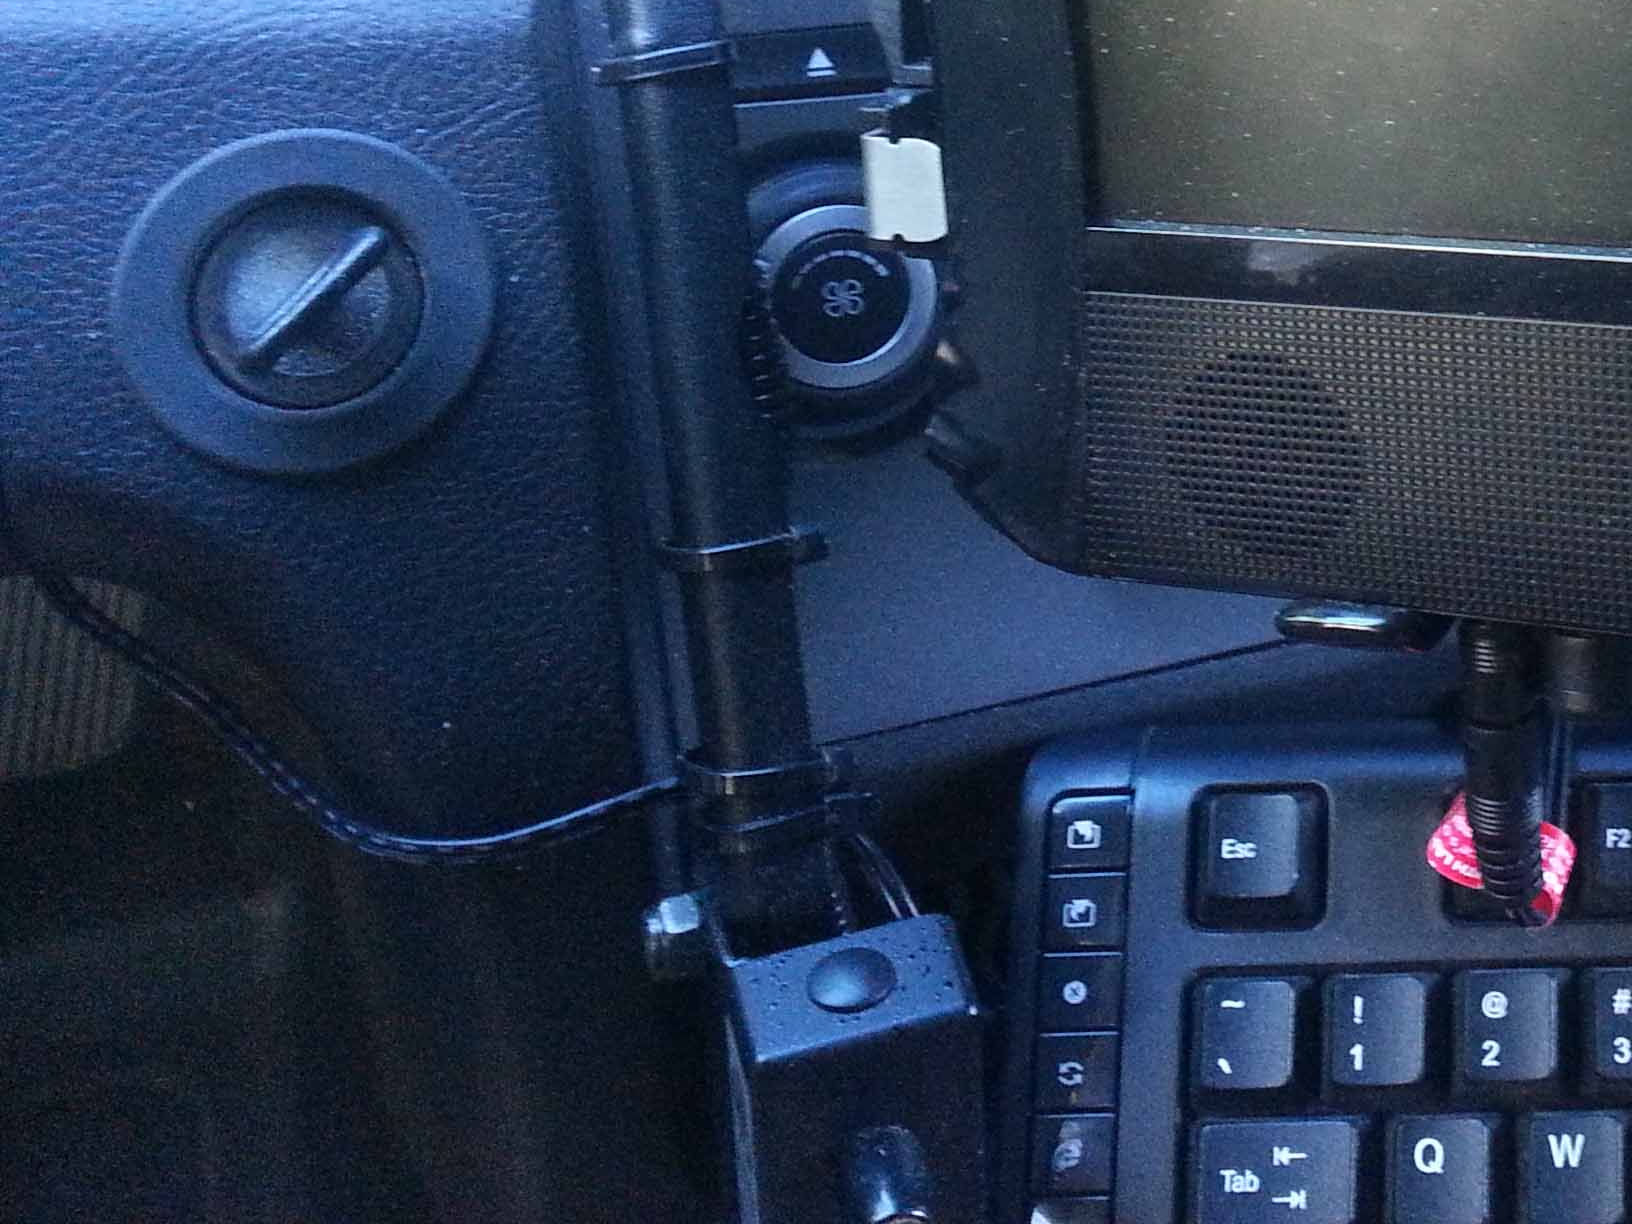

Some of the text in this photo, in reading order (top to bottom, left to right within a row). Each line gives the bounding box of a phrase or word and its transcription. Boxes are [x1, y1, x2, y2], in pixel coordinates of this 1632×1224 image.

[1221, 838, 1258, 859] Esc
[1605, 828, 1632, 849] F2
[1481, 990, 1509, 1019] @
[1612, 988, 1632, 1015] #
[1349, 1043, 1364, 1071] 1
[1481, 1039, 1501, 1067] 2
[1613, 1036, 1632, 1064] 3
[1413, 1137, 1445, 1174] Q
[1547, 1133, 1585, 1169] W
[1219, 1168, 1260, 1193] Tab
